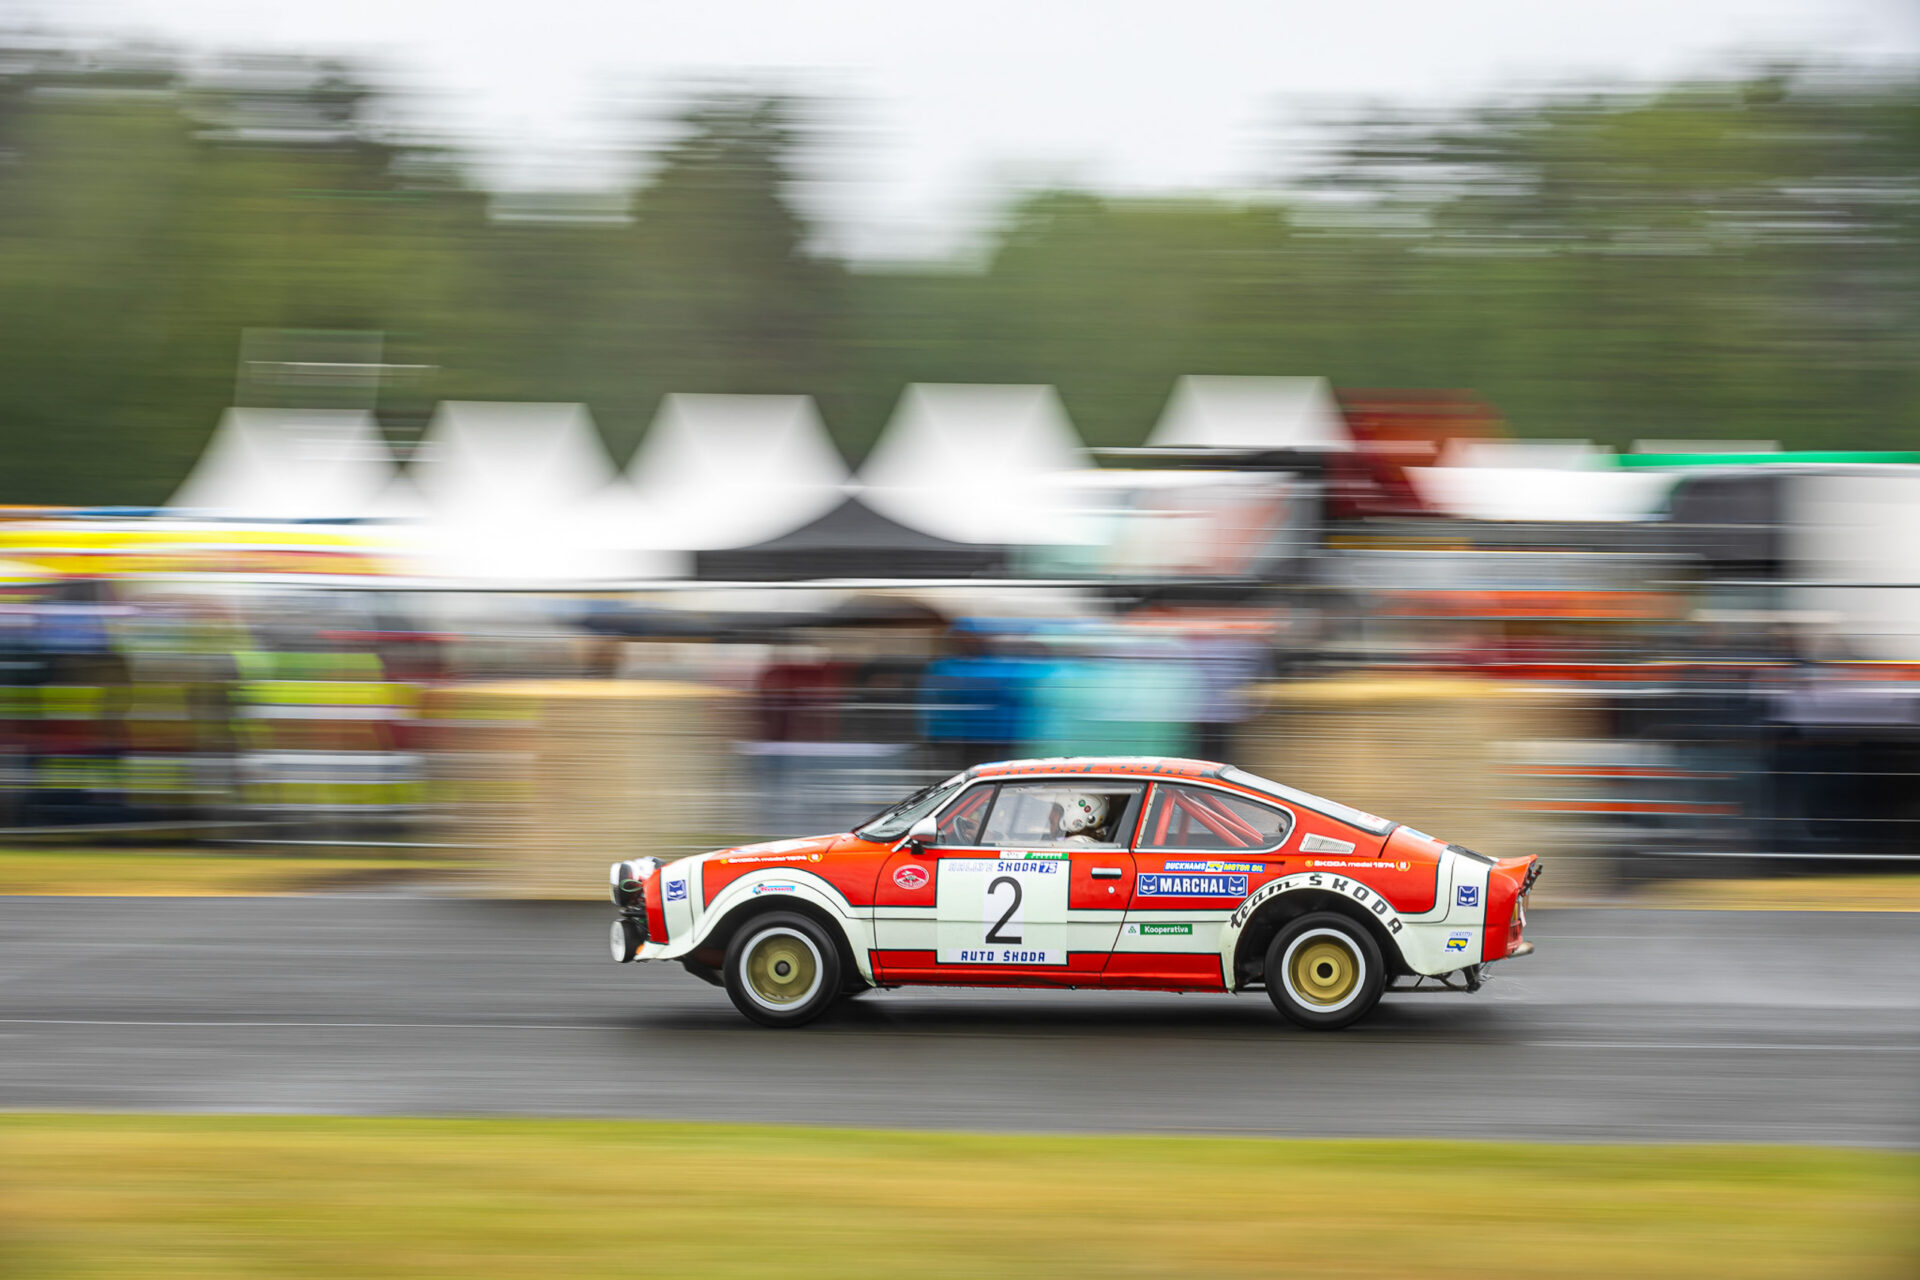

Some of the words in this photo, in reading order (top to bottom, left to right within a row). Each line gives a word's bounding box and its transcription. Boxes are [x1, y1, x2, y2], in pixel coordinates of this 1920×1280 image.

[1164, 862, 1206, 870] DUCKHAMS
[1223, 862, 1250, 872] MOTOR
[1251, 864, 1264, 872] OIL
[1160, 878, 1226, 893] MARCHAL
[1231, 879, 1299, 928] team
[985, 876, 1022, 944] 2
[1144, 925, 1189, 934] Kooperativa
[961, 951, 995, 961] AUTO
